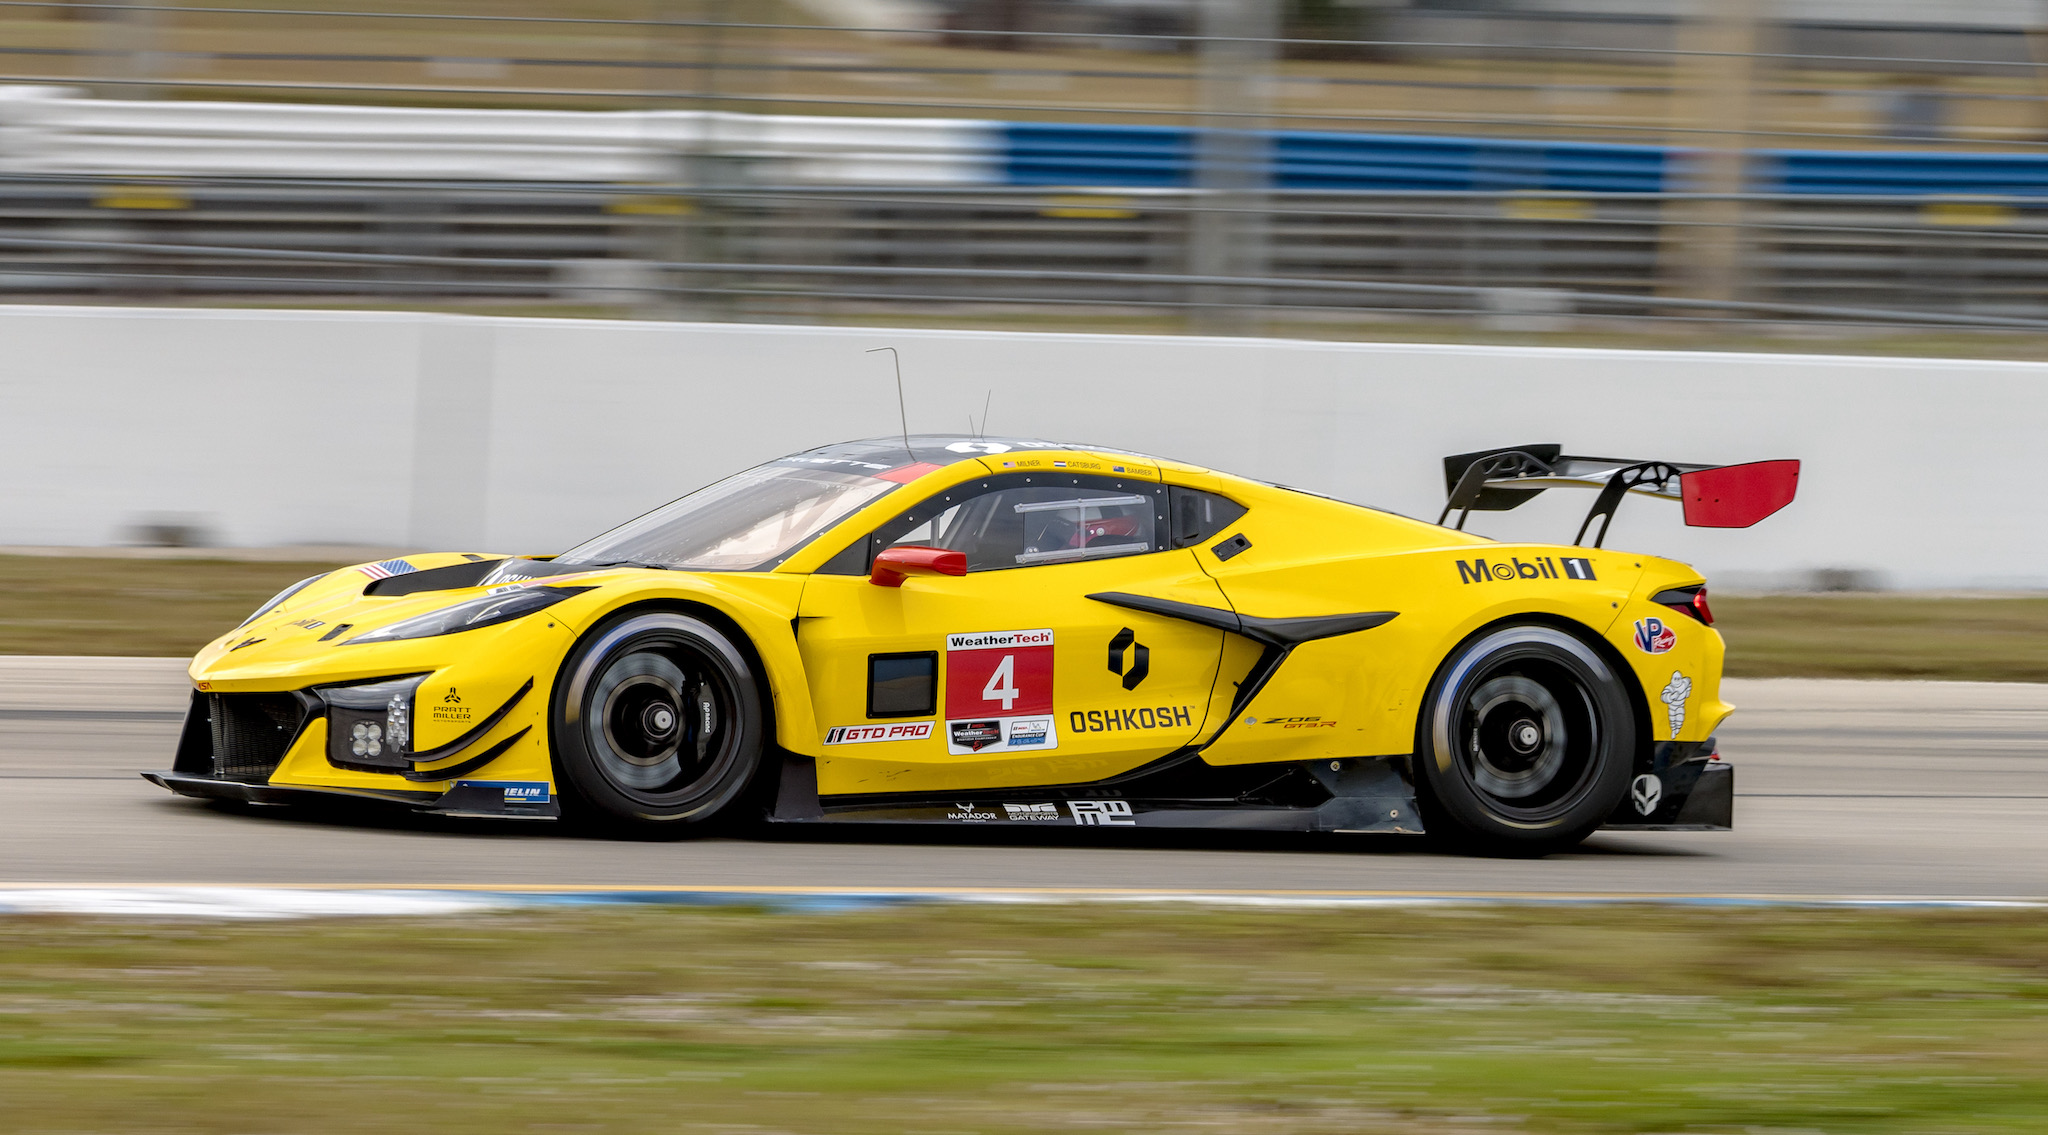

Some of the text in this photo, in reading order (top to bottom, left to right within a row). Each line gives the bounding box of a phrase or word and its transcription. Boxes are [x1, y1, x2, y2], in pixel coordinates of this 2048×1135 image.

[1067, 461, 1101, 470] CATSBURG
[1126, 468, 1152, 476] BAMBER
[1456, 557, 1559, 584] Mobil
[951, 633, 1049, 647] WeatherTech
[1635, 618, 1662, 652] VP
[982, 655, 1019, 710] 4
[1069, 705, 1192, 733] OSHKOSH
[1262, 716, 1321, 724] Z06
[846, 725, 930, 740] GTD PRO
[947, 812, 998, 820] MATADOR
